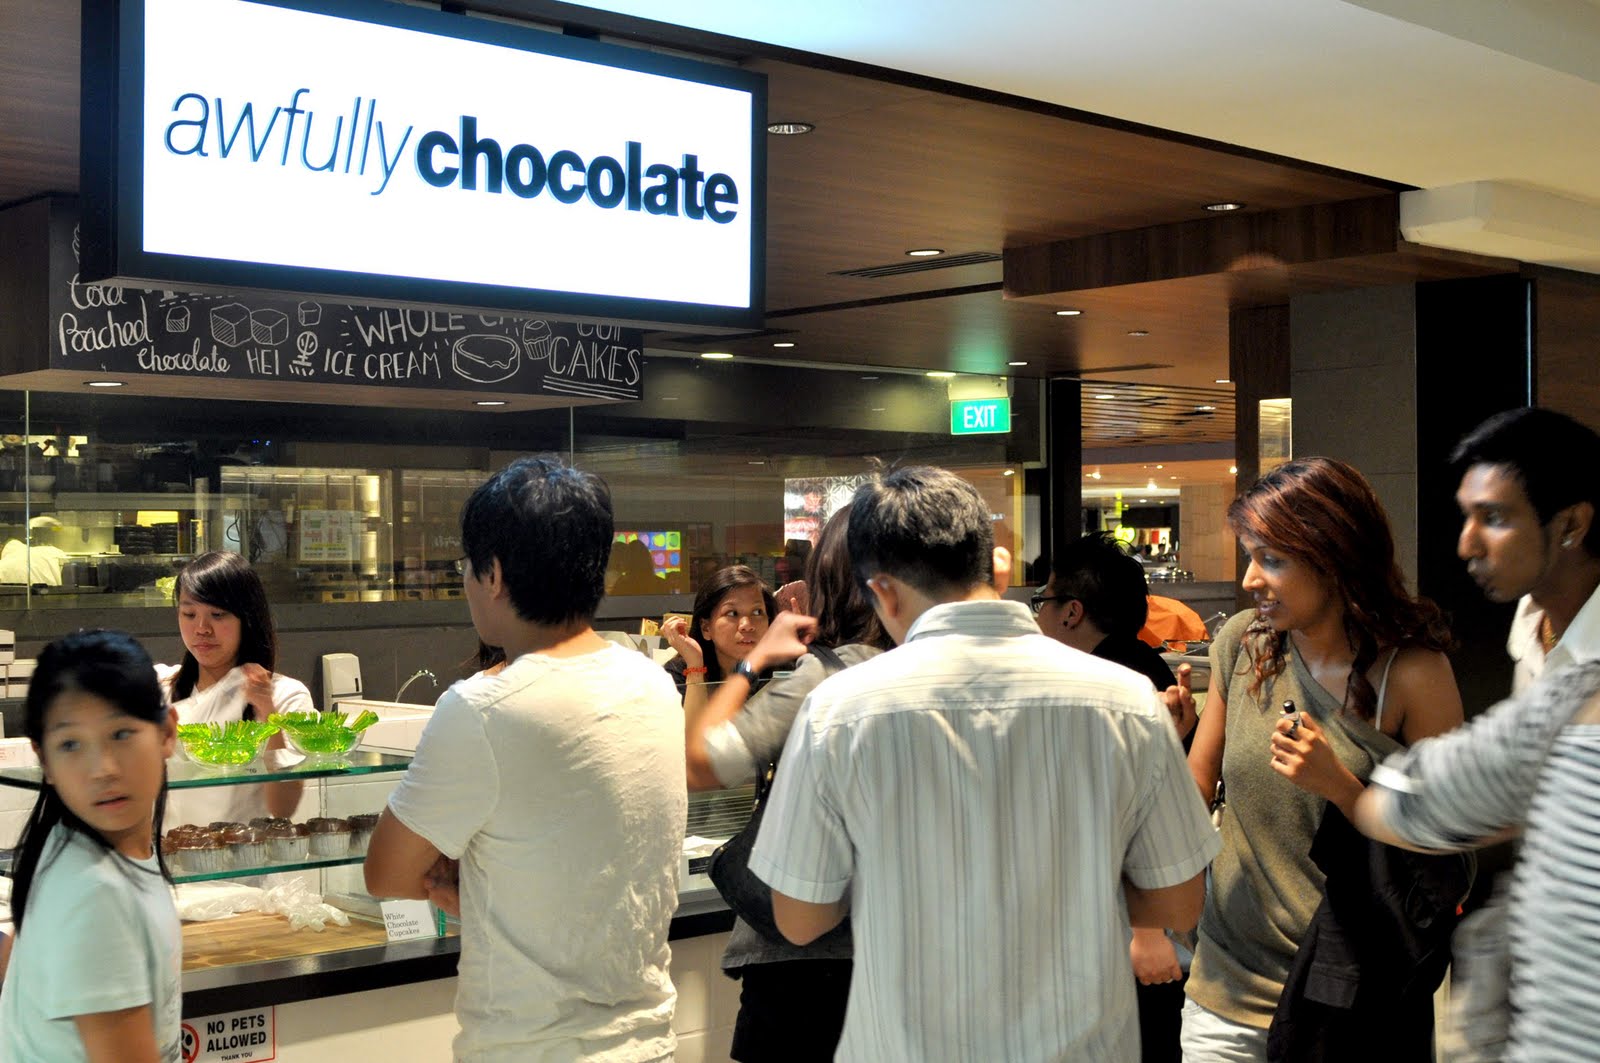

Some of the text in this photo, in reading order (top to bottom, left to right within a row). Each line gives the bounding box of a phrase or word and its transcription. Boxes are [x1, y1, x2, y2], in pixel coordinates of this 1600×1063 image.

[164, 88, 739, 224] awfully chocolate
[354, 308, 466, 347] WHOLE
[246, 347, 280, 376] HEI
[324, 348, 441, 380] ICE CREAM
[549, 336, 641, 386] CAKES
[963, 405, 998, 429] EXIT
[385, 912, 405, 921] White
[386, 919, 419, 929] Chocolate
[389, 927, 420, 937] Cupcakes
[207, 1014, 265, 1035] NO PETS
[206, 1031, 267, 1053] ALLOWED
[221, 1051, 253, 1062] THANK YOU
